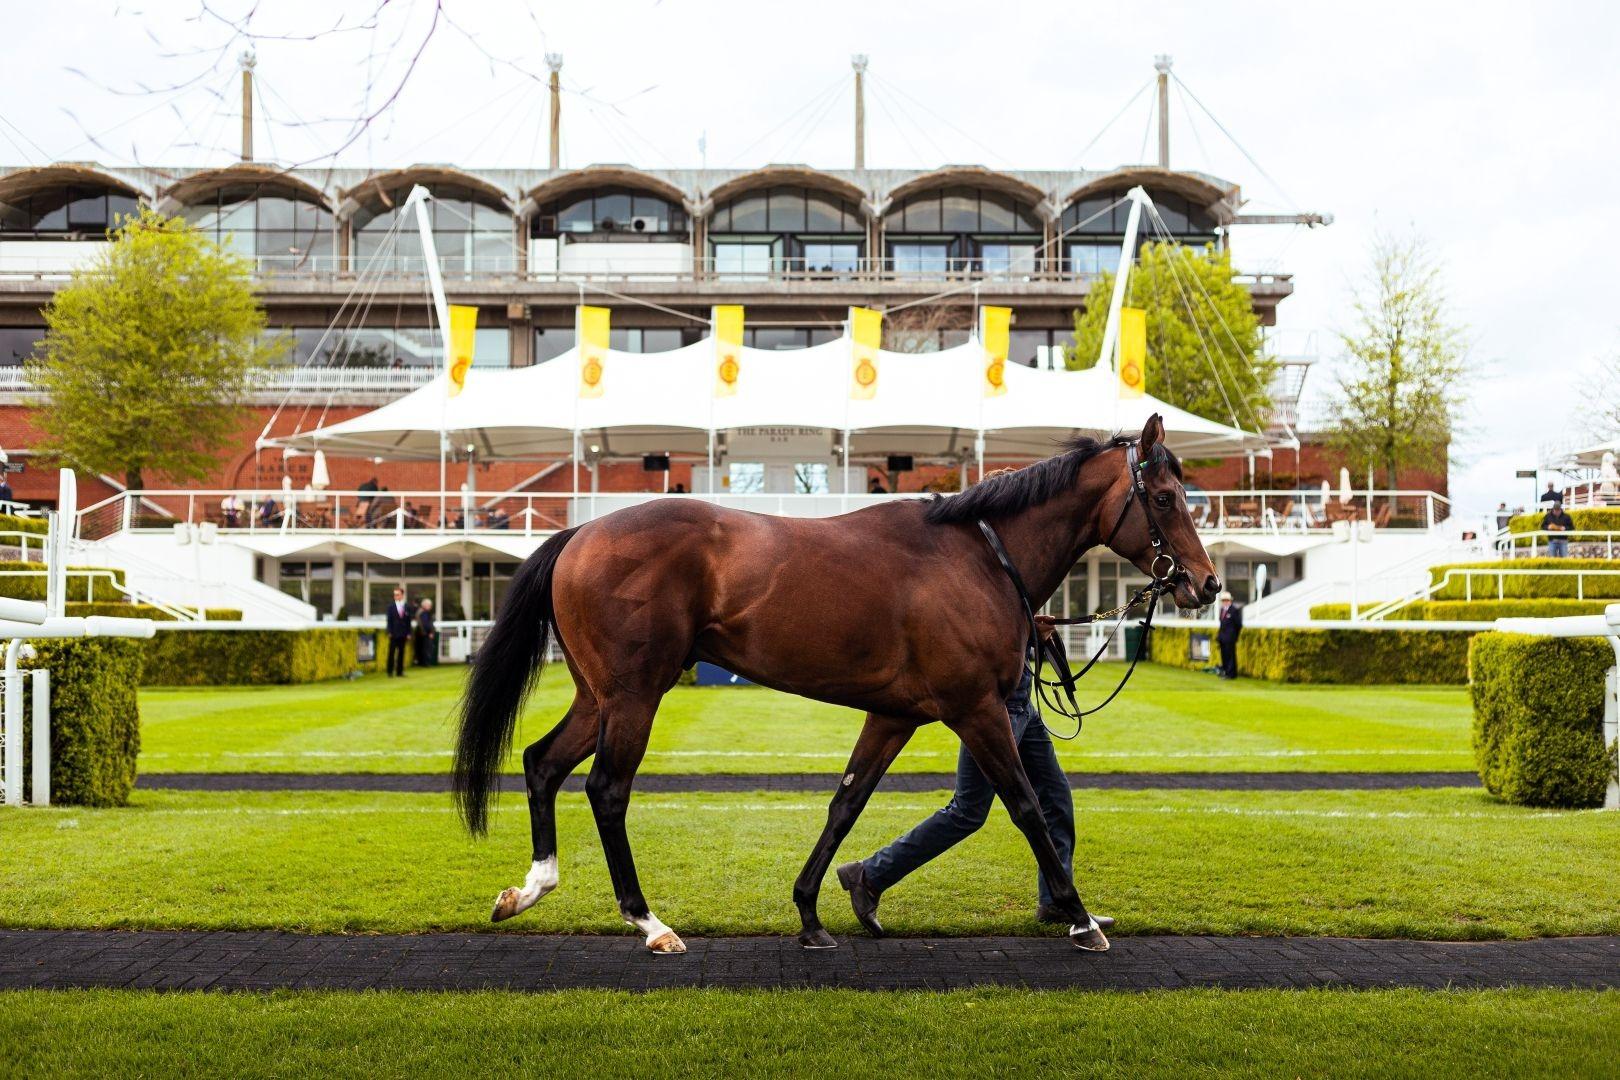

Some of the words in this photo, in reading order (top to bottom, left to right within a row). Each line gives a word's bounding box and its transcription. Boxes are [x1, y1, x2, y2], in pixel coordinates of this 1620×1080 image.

[737, 428, 755, 436] THE
[758, 428, 795, 436] PARADE
[799, 428, 823, 436] RING
